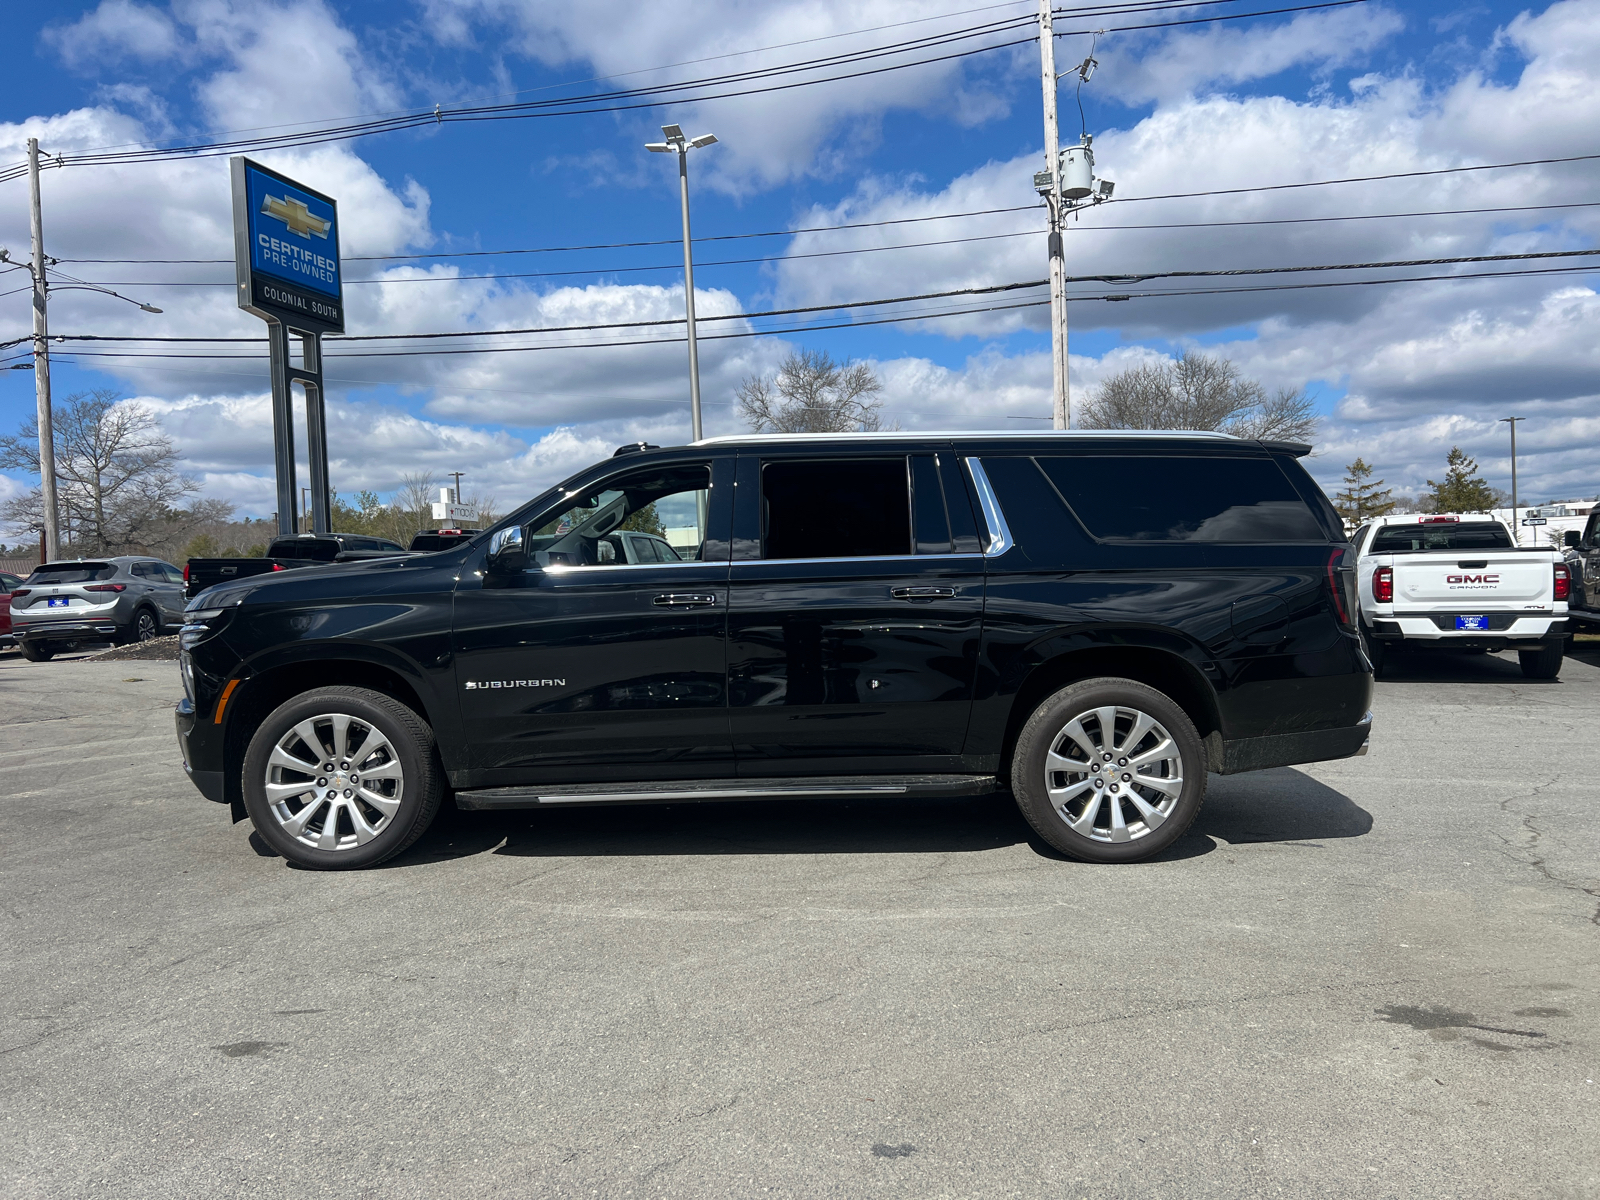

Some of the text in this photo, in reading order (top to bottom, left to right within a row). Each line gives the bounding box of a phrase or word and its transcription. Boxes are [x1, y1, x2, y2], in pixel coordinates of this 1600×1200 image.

[258, 233, 336, 272] CERTIFIED
[264, 248, 334, 284] PRE-OWNED
[264, 286, 338, 319] COLONIAL SOUTH
[1446, 574, 1500, 584] GMC
[465, 678, 566, 690] SUBURBAN
